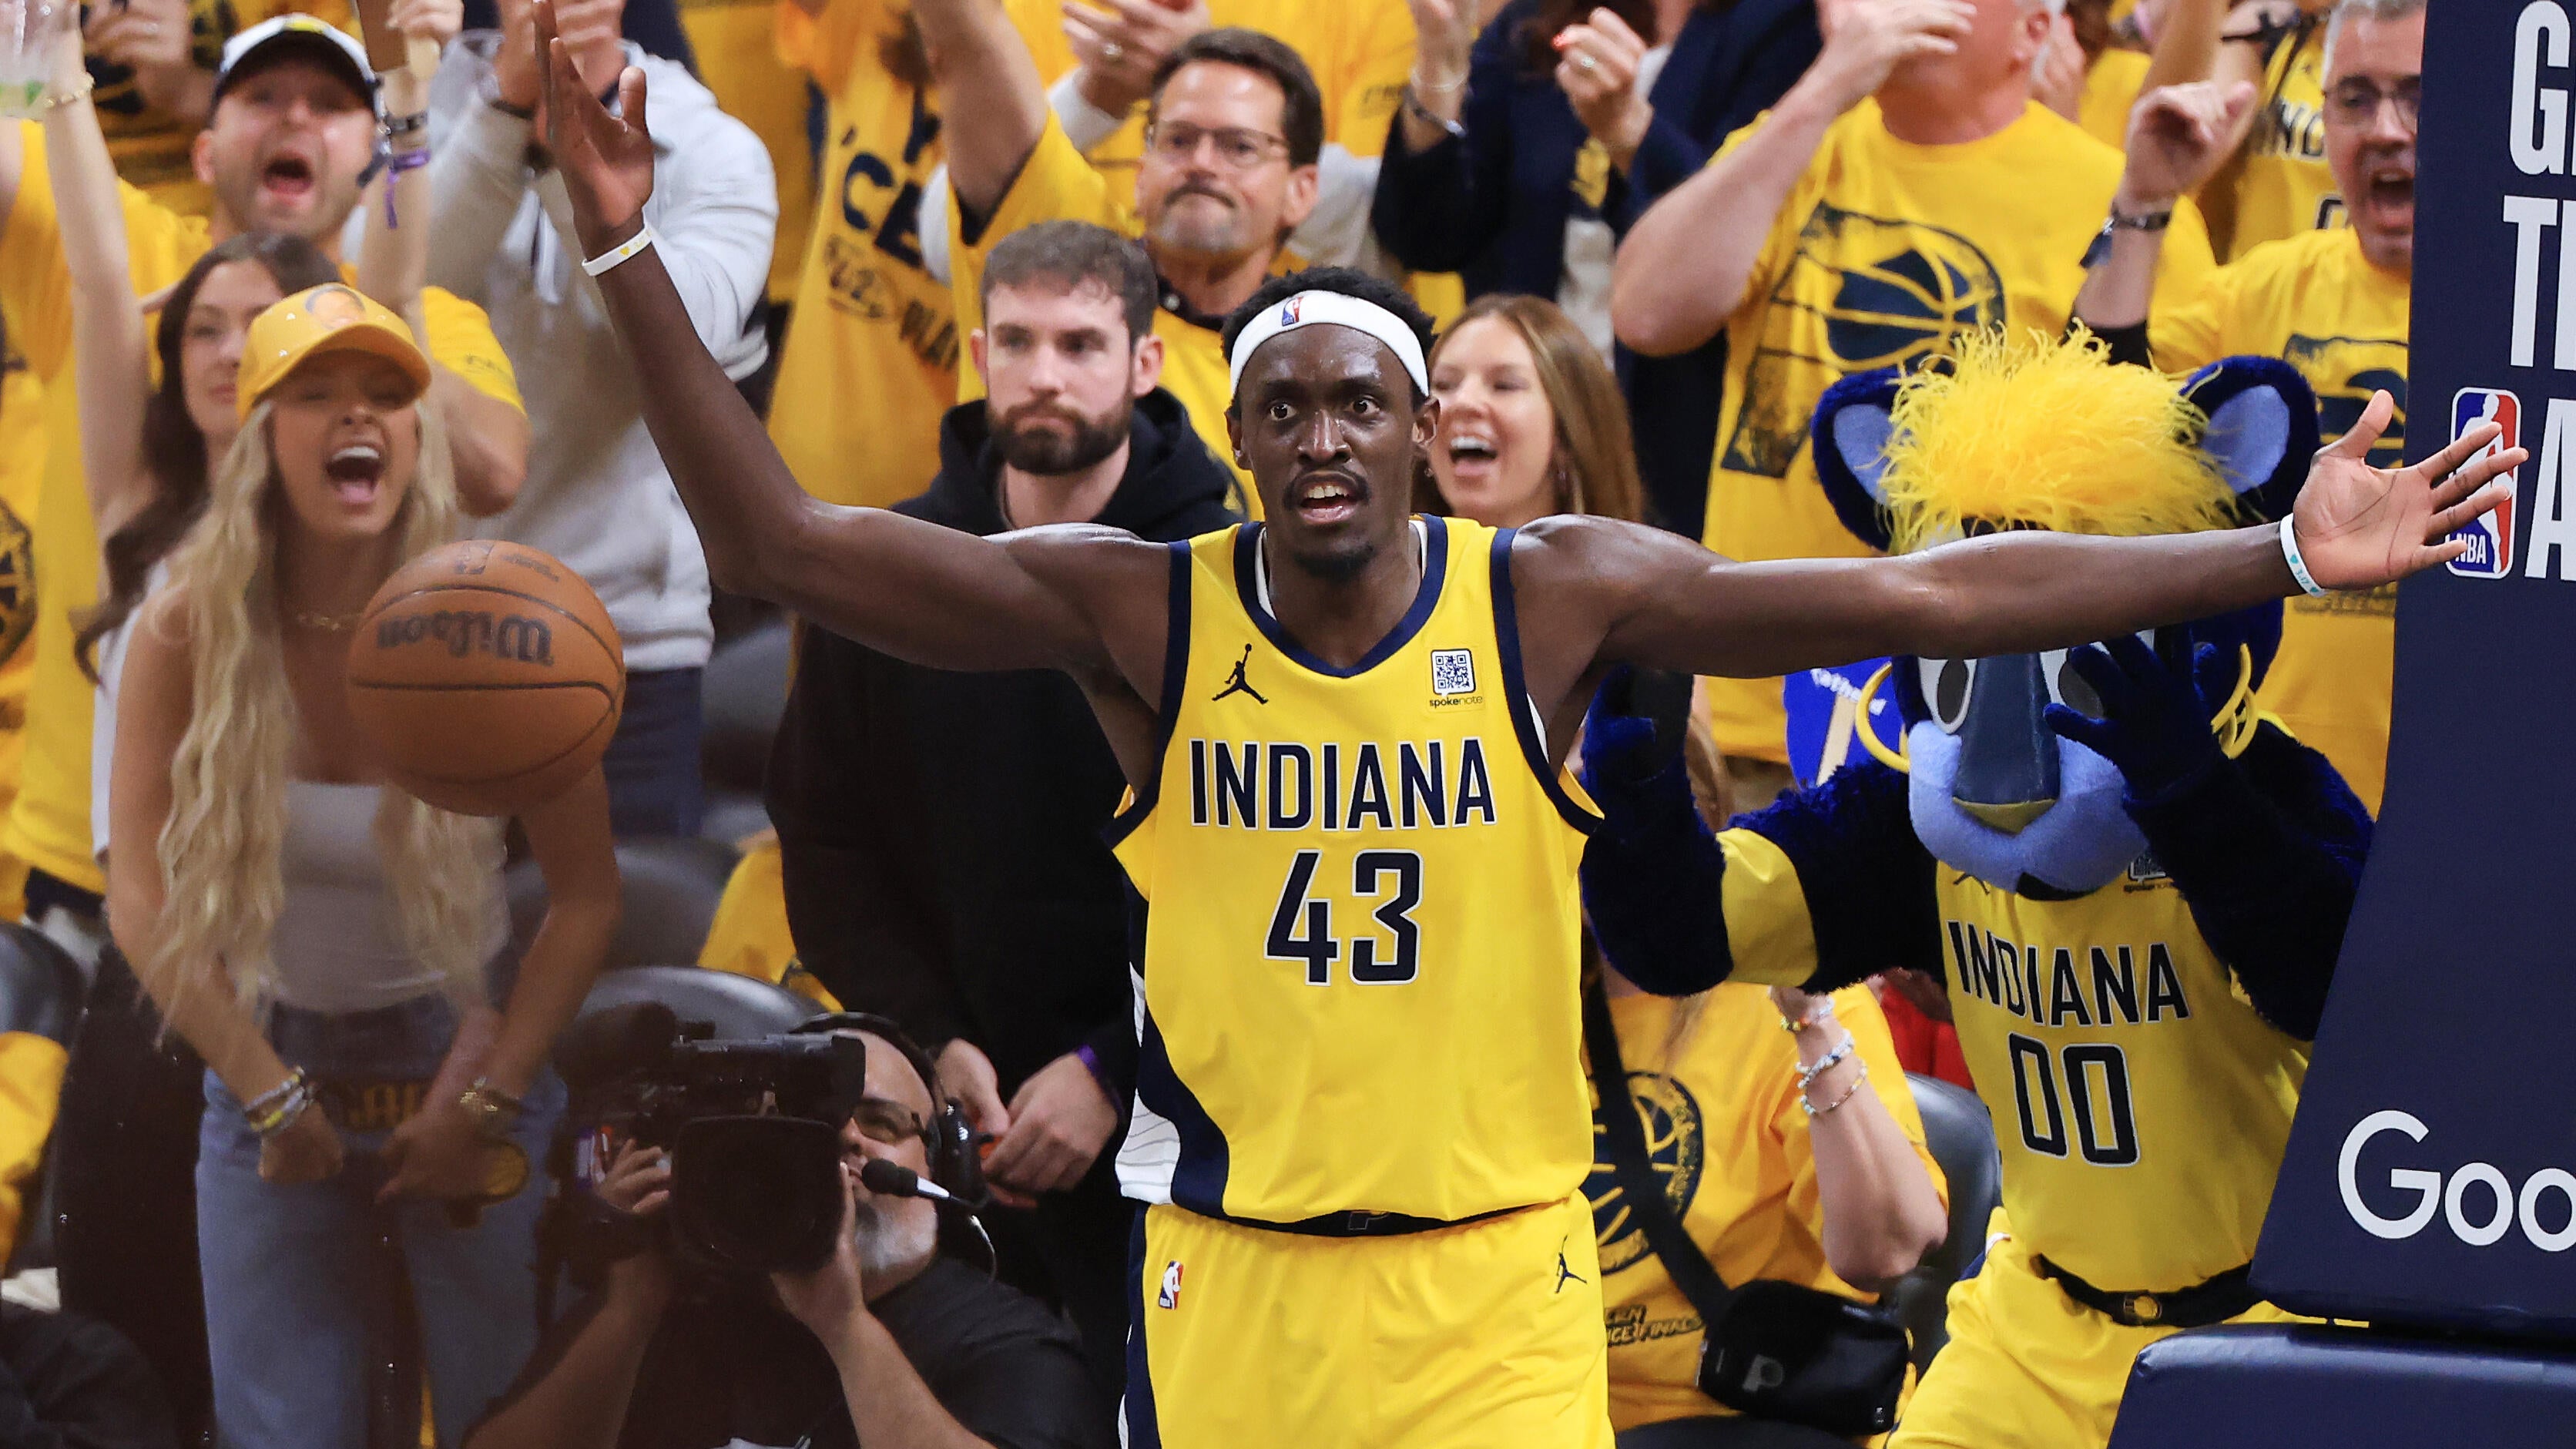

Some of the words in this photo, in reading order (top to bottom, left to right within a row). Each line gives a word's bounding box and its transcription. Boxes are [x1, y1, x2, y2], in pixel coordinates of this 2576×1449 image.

[2509, 0, 2576, 176] G
[376, 610, 553, 665] Wilson
[1430, 696, 1483, 709] spokenote
[1189, 737, 1498, 831] INDIANA
[1263, 849, 1424, 987] 43
[1947, 920, 2191, 1027] INDIANA
[2008, 1031, 2140, 1167] 00
[2338, 1110, 2576, 1252] Goo
